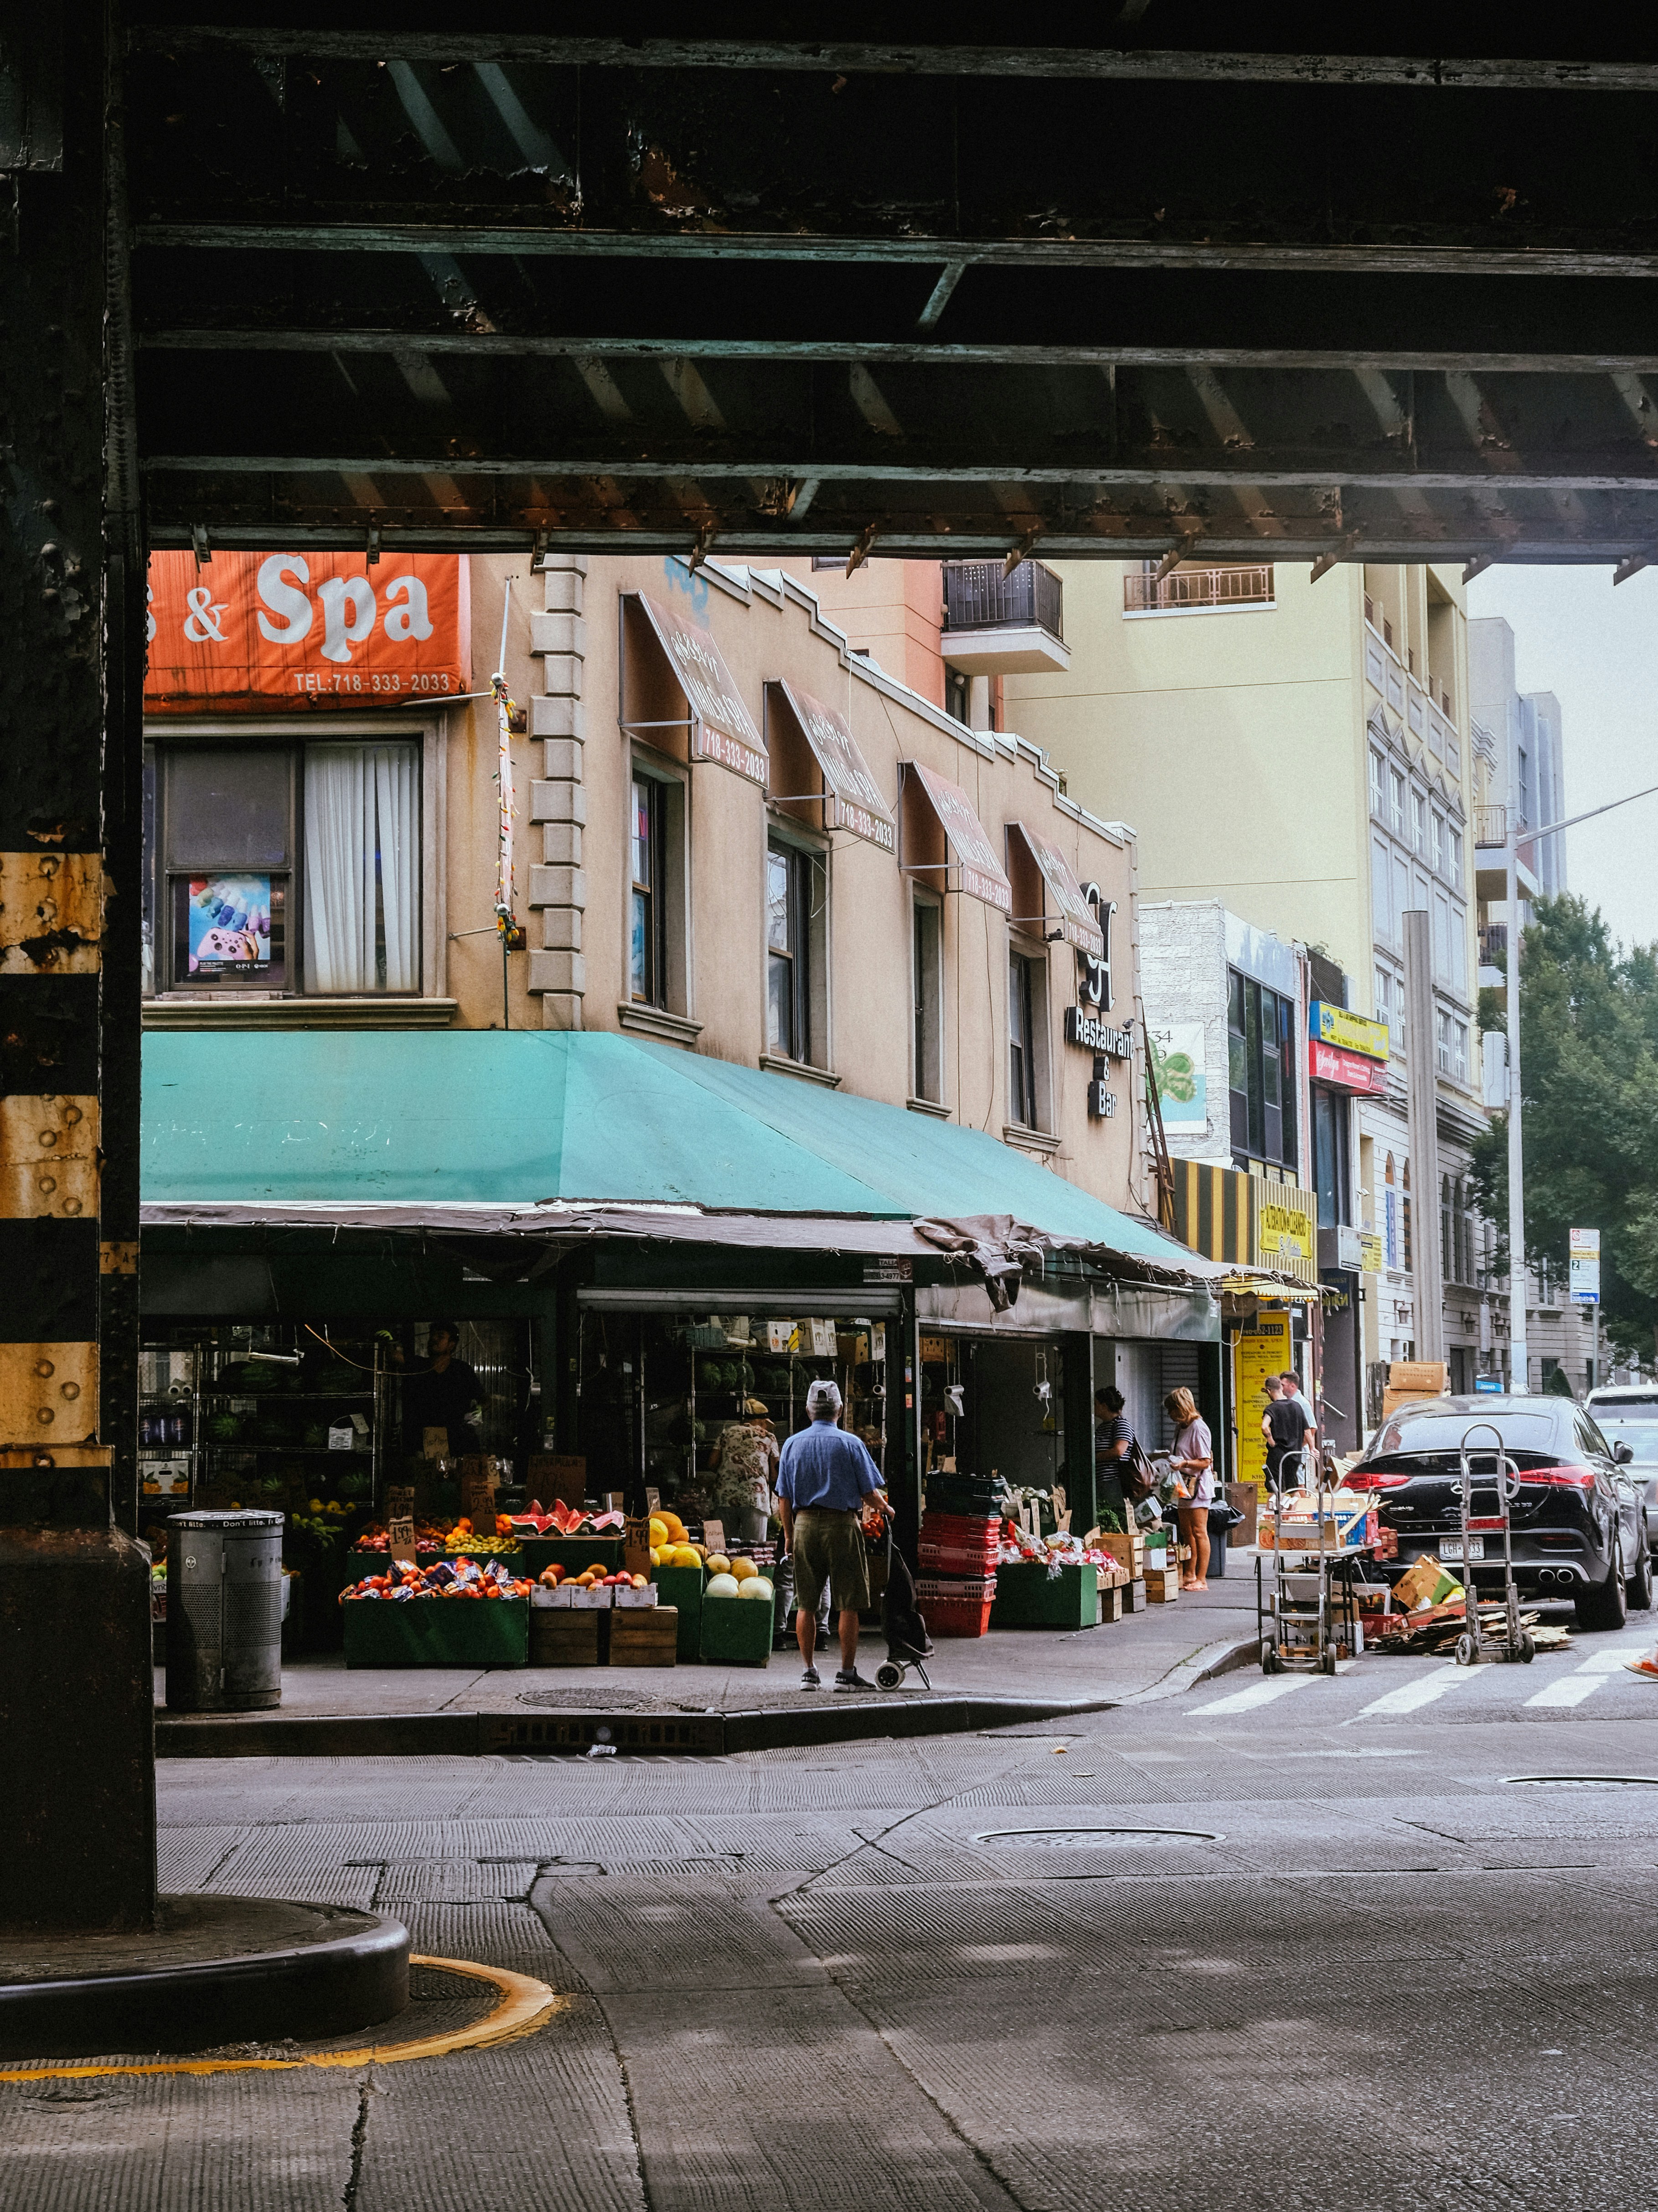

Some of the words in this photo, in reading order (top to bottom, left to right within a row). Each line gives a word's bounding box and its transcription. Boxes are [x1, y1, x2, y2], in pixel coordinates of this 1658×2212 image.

[184, 587, 229, 642] &
[257, 554, 434, 663] Spa
[294, 673, 449, 692] TEL:718-333-2033
[685, 673, 722, 720] NAILS
[722, 694, 755, 740] SPA
[705, 729, 764, 783] 718-333-2033
[821, 751, 855, 793] NAILS
[854, 770, 883, 809] SPA
[841, 802, 892, 847] 718-333-2033
[977, 842, 1001, 874] SPA
[967, 872, 1010, 909] 718-333-2033
[1069, 921, 1102, 956] 718-333-2033
[1076, 1006, 1135, 1059] Restaurant
[1104, 1056, 1110, 1081] &
[1099, 1081, 1117, 1118] Bar
